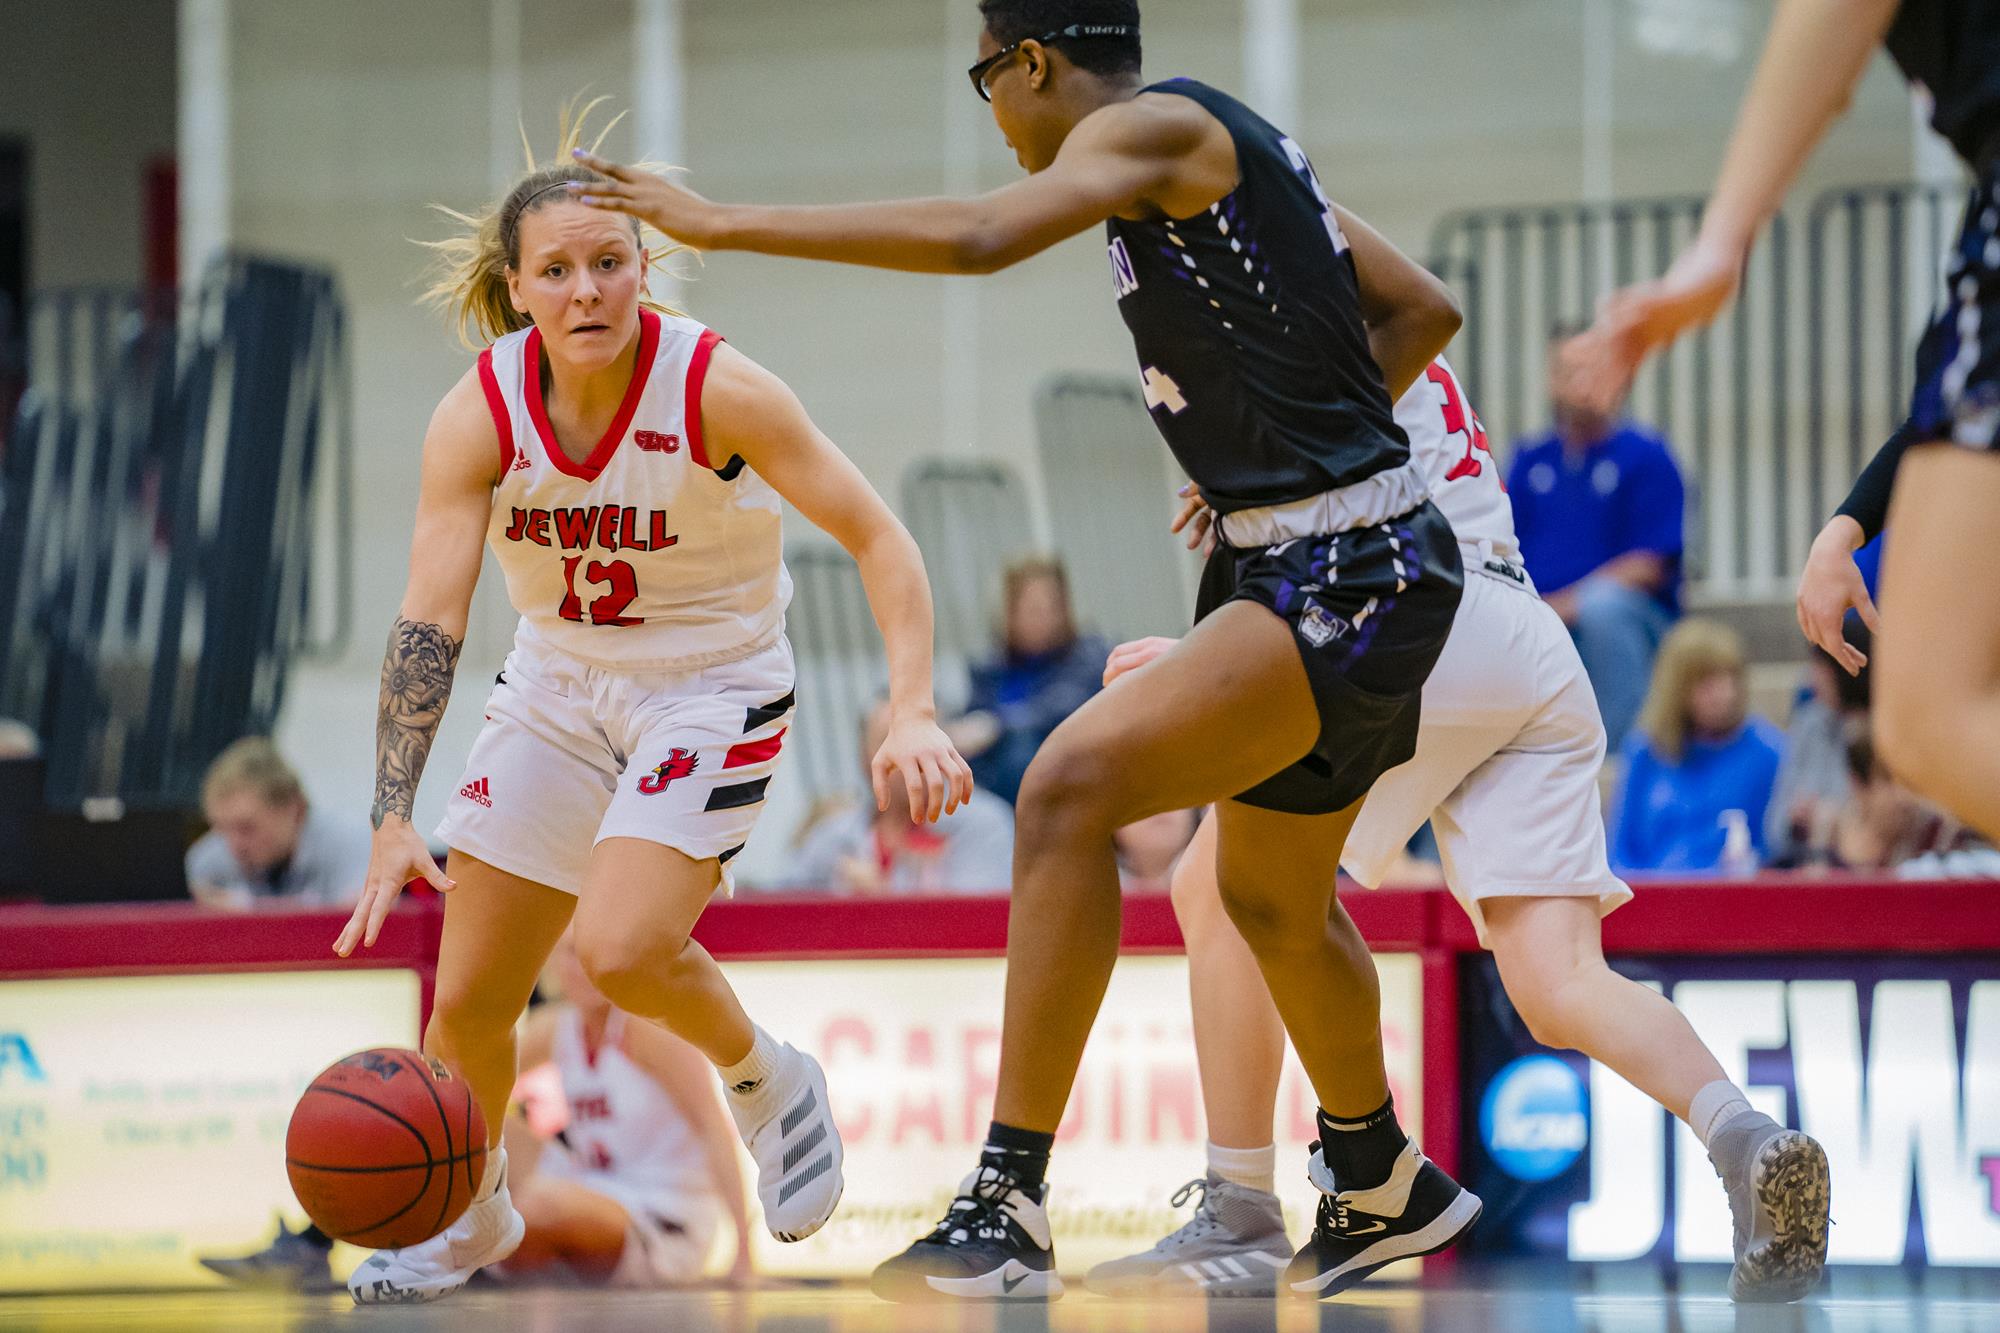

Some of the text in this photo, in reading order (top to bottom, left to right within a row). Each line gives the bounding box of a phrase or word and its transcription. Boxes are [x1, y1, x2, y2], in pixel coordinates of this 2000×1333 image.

[505, 504, 679, 552] JEWELL
[559, 554, 645, 627] 12
[460, 788, 493, 808] adidas
